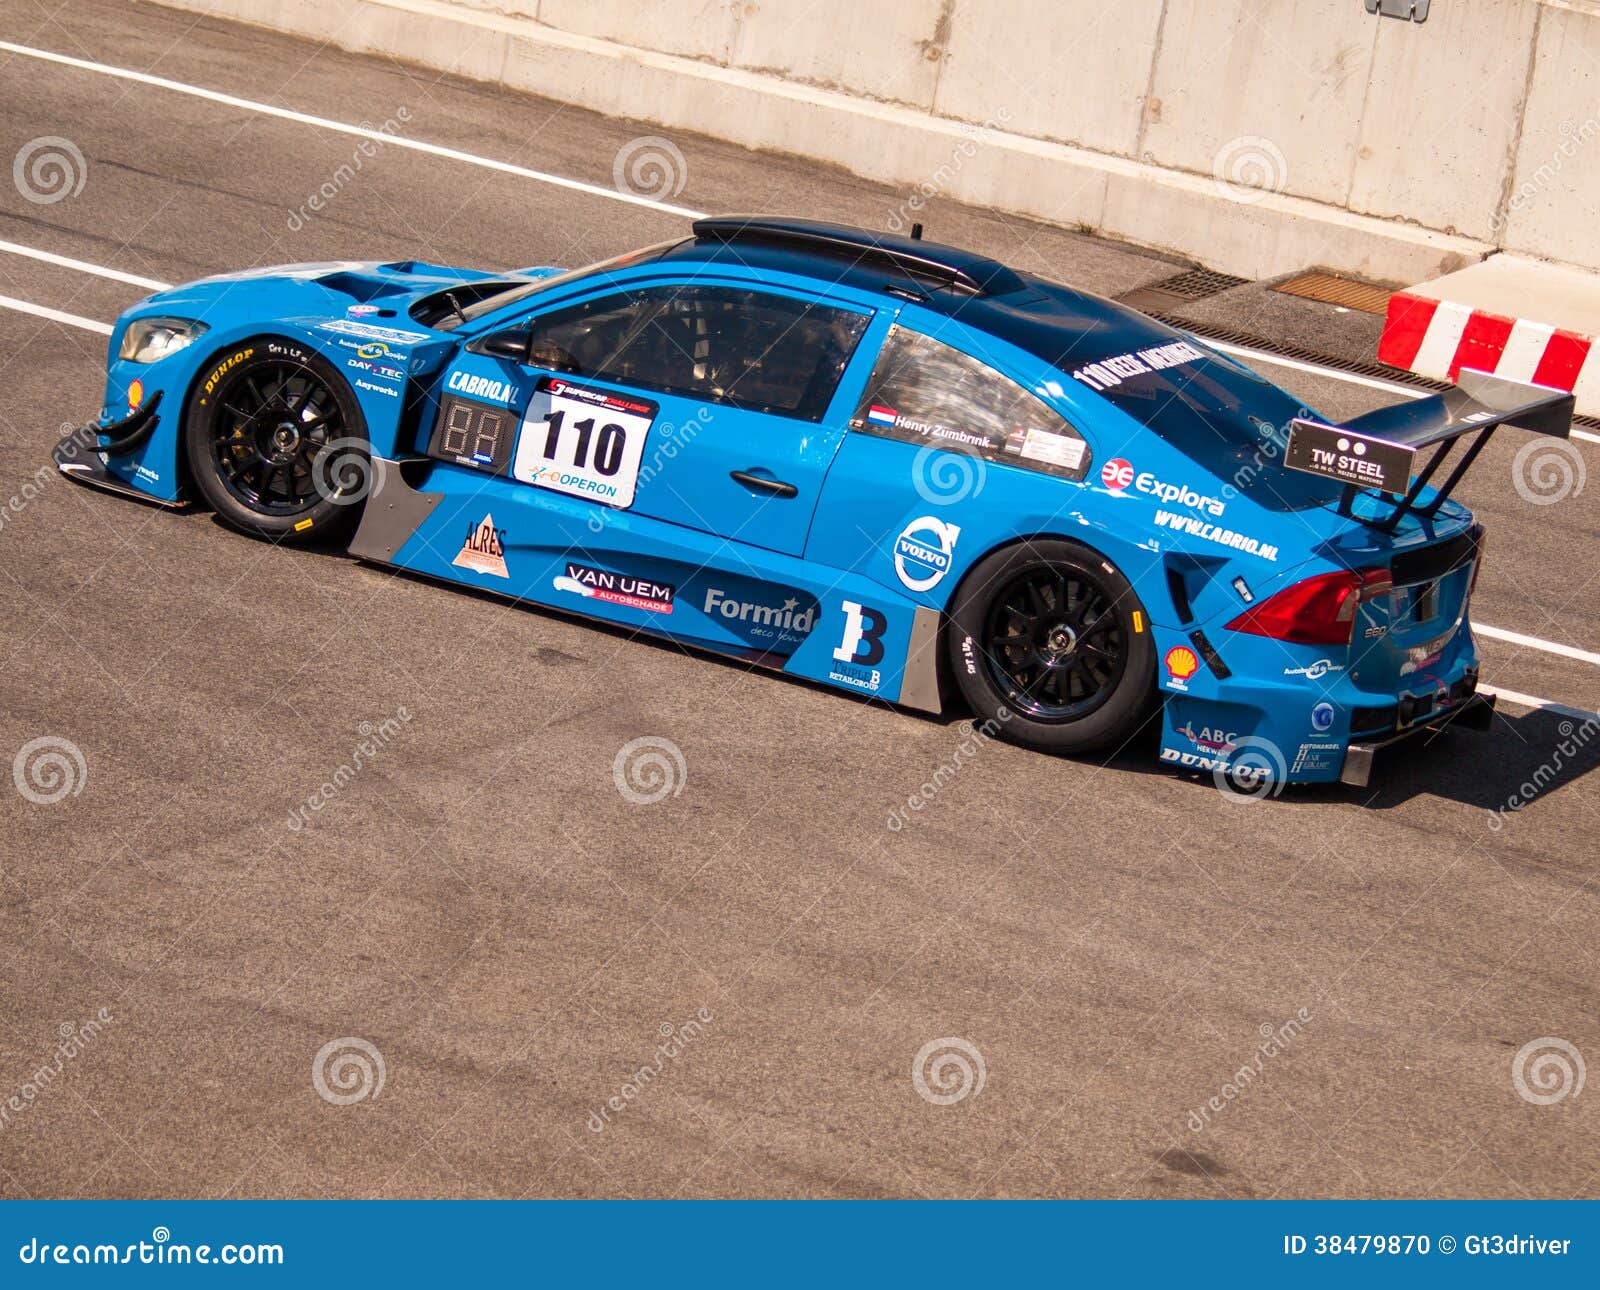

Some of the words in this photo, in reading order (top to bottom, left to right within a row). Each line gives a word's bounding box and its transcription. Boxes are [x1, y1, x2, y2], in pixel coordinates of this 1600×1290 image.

[204, 348, 254, 395] DUNLOP
[449, 370, 520, 405] CABRIO.NL
[543, 410, 626, 477] 110
[895, 415, 931, 436] Henry
[934, 424, 991, 448] Zumbrink
[1312, 448, 1336, 466] TW
[1337, 456, 1385, 479] STEEL
[1135, 472, 1226, 517] Explora
[463, 521, 507, 557] ALRES
[1154, 509, 1279, 562] WWW.CABRIO.NL
[900, 540, 947, 568] VOLVO
[568, 565, 614, 589] VAN
[620, 578, 670, 600] UEM
[599, 591, 668, 612] AUTOSCHADE
[704, 588, 820, 633] Formid
[829, 671, 879, 691] RETAILGROUP
[1200, 727, 1238, 746] ABC
[1160, 748, 1271, 780] DUNLOP
